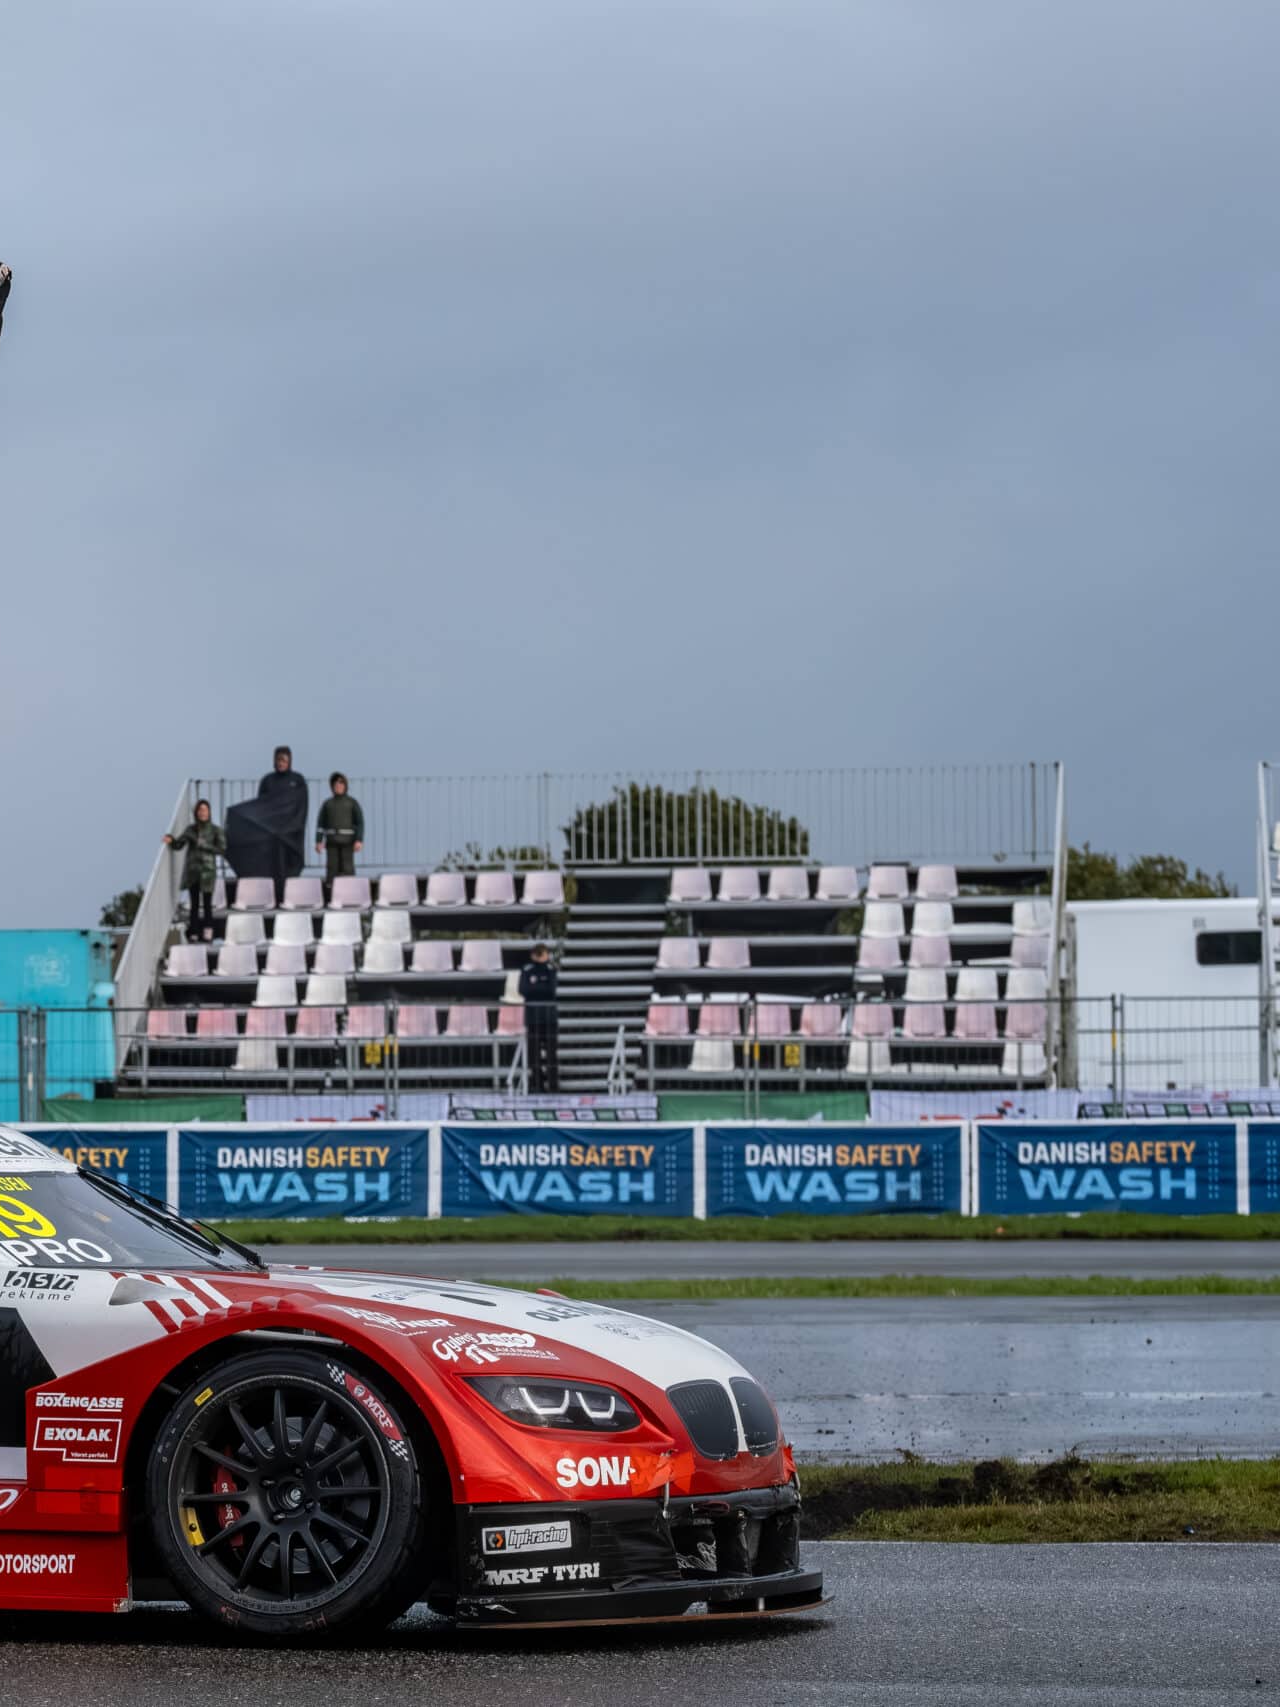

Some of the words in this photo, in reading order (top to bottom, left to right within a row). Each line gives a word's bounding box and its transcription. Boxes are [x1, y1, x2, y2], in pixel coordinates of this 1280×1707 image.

[218, 1171, 390, 1203] WASH
[480, 1170, 655, 1203] WASH
[746, 1170, 922, 1203] WASH
[1019, 1168, 1197, 1200] WASH
[0, 1238, 113, 1266] PRO
[0, 1289, 72, 1301] reklame
[35, 1393, 124, 1412] BOXENGASSE
[363, 1395, 393, 1428] MRF
[44, 1427, 112, 1441] EXOLAK
[485, 1567, 549, 1586] MRF
[553, 1562, 600, 1581] TYRI
